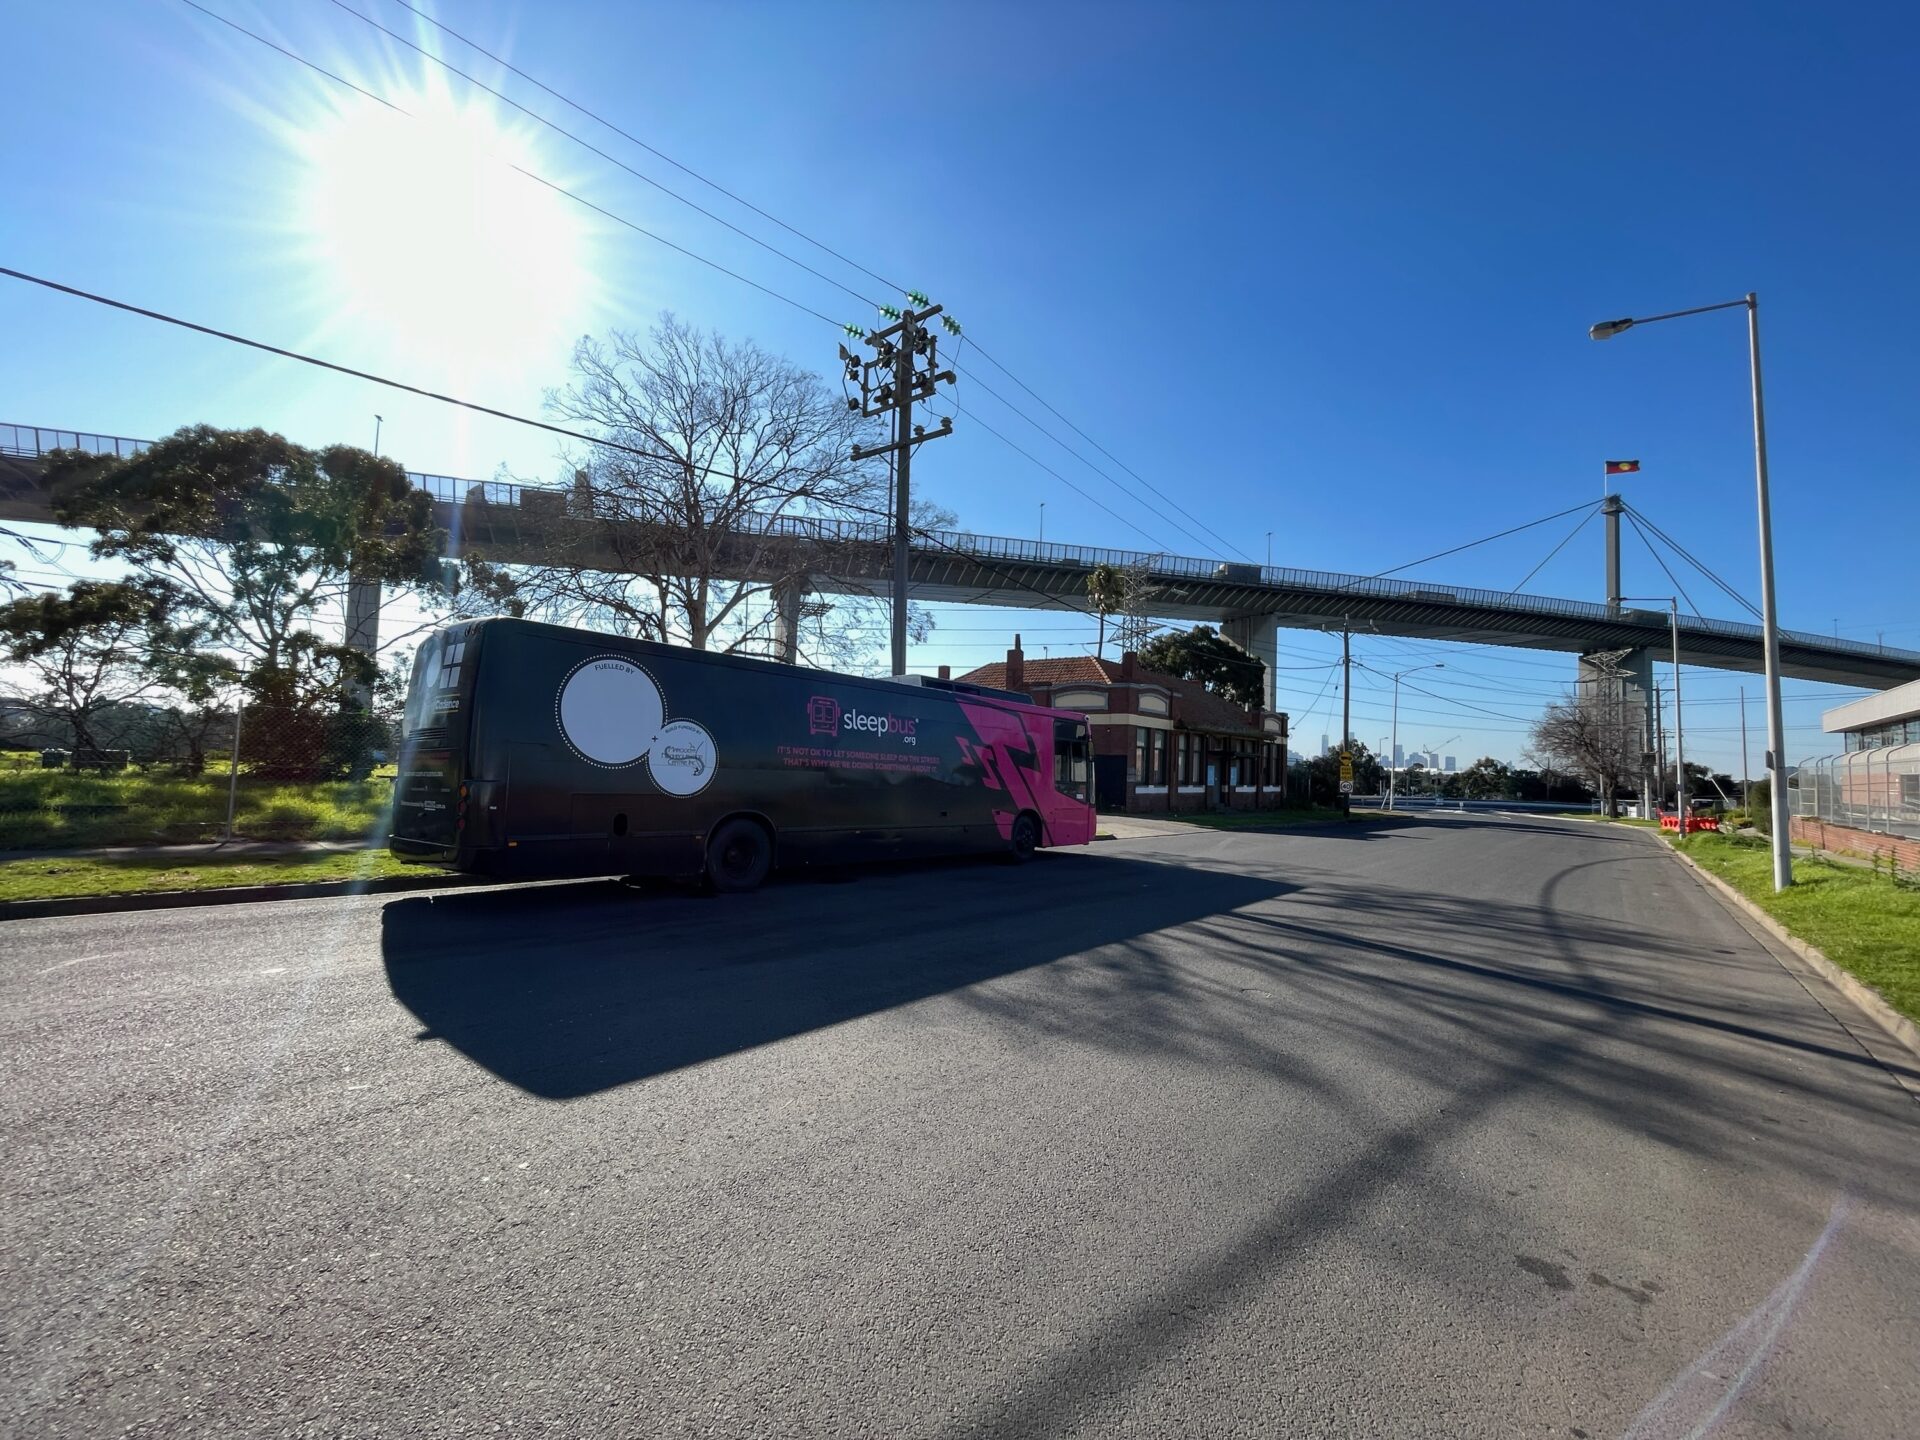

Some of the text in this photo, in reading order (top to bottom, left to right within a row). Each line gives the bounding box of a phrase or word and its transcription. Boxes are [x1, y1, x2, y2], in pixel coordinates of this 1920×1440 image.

[594, 663, 635, 675] FUELLED BY
[843, 708, 916, 737] sleepbus
[777, 745, 791, 754] IT'S
[793, 746, 809, 756] NOT
[810, 748, 821, 757] OK
[822, 748, 832, 757] TO
[833, 749, 845, 758] LET
[846, 750, 880, 760] SOMEONE
[880, 752, 897, 761] SLEEP
[898, 753, 908, 762] ON
[783, 757, 809, 767] THAT'S
[811, 758, 828, 768] WHY
[851, 761, 873, 770] DOING
[875, 762, 911, 771] SOMETHING
[912, 763, 931, 773] ABOUT
